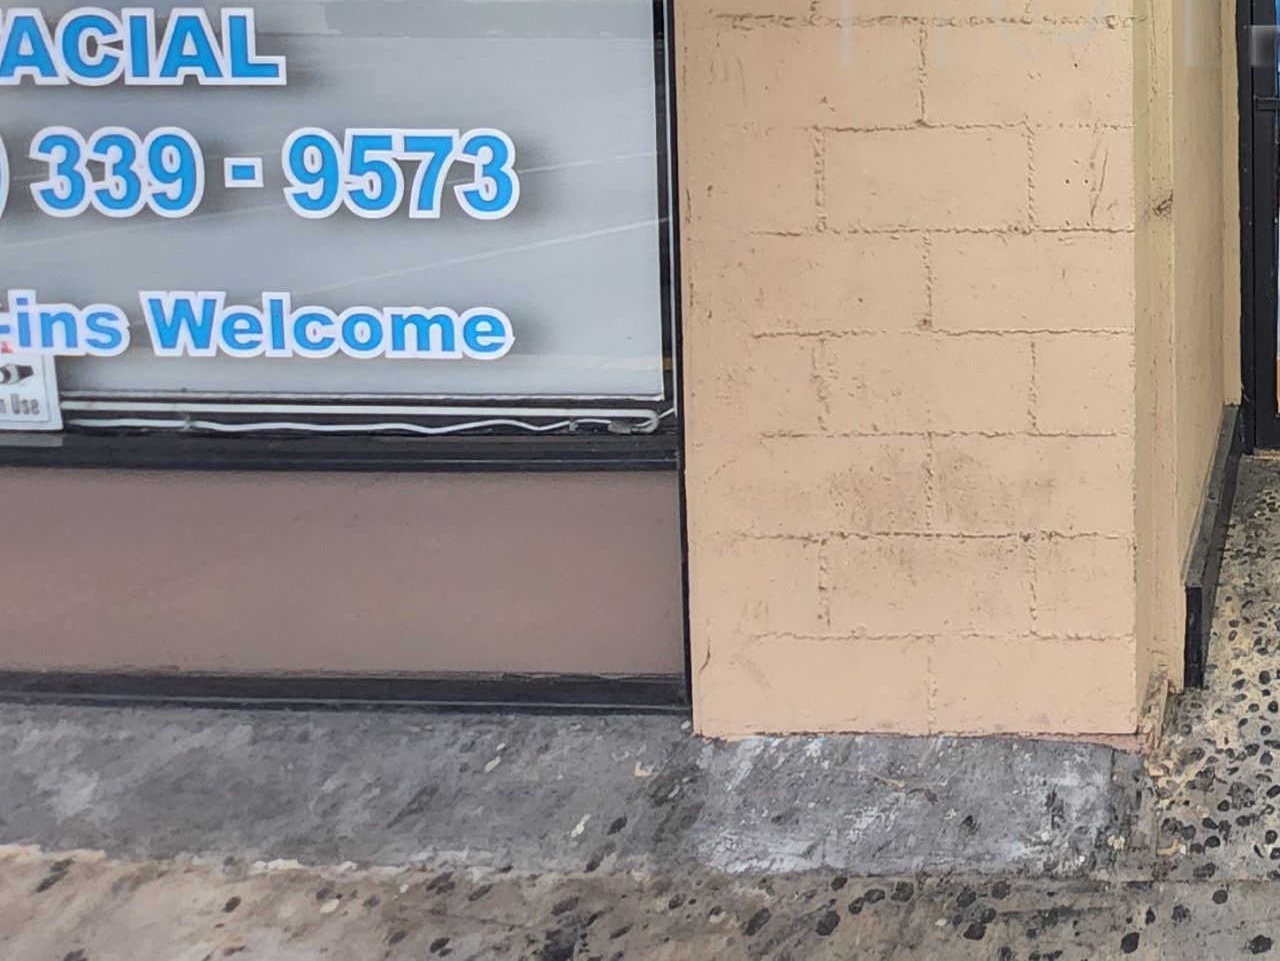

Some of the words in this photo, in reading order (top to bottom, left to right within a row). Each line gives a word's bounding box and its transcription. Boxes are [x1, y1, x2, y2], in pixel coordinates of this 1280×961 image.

[0, 7, 286, 85] ACIAL
[28, 127, 206, 218] 339
[224, 158, 263, 188] -
[281, 128, 520, 219] 9573
[138, 291, 516, 360] Welcome
